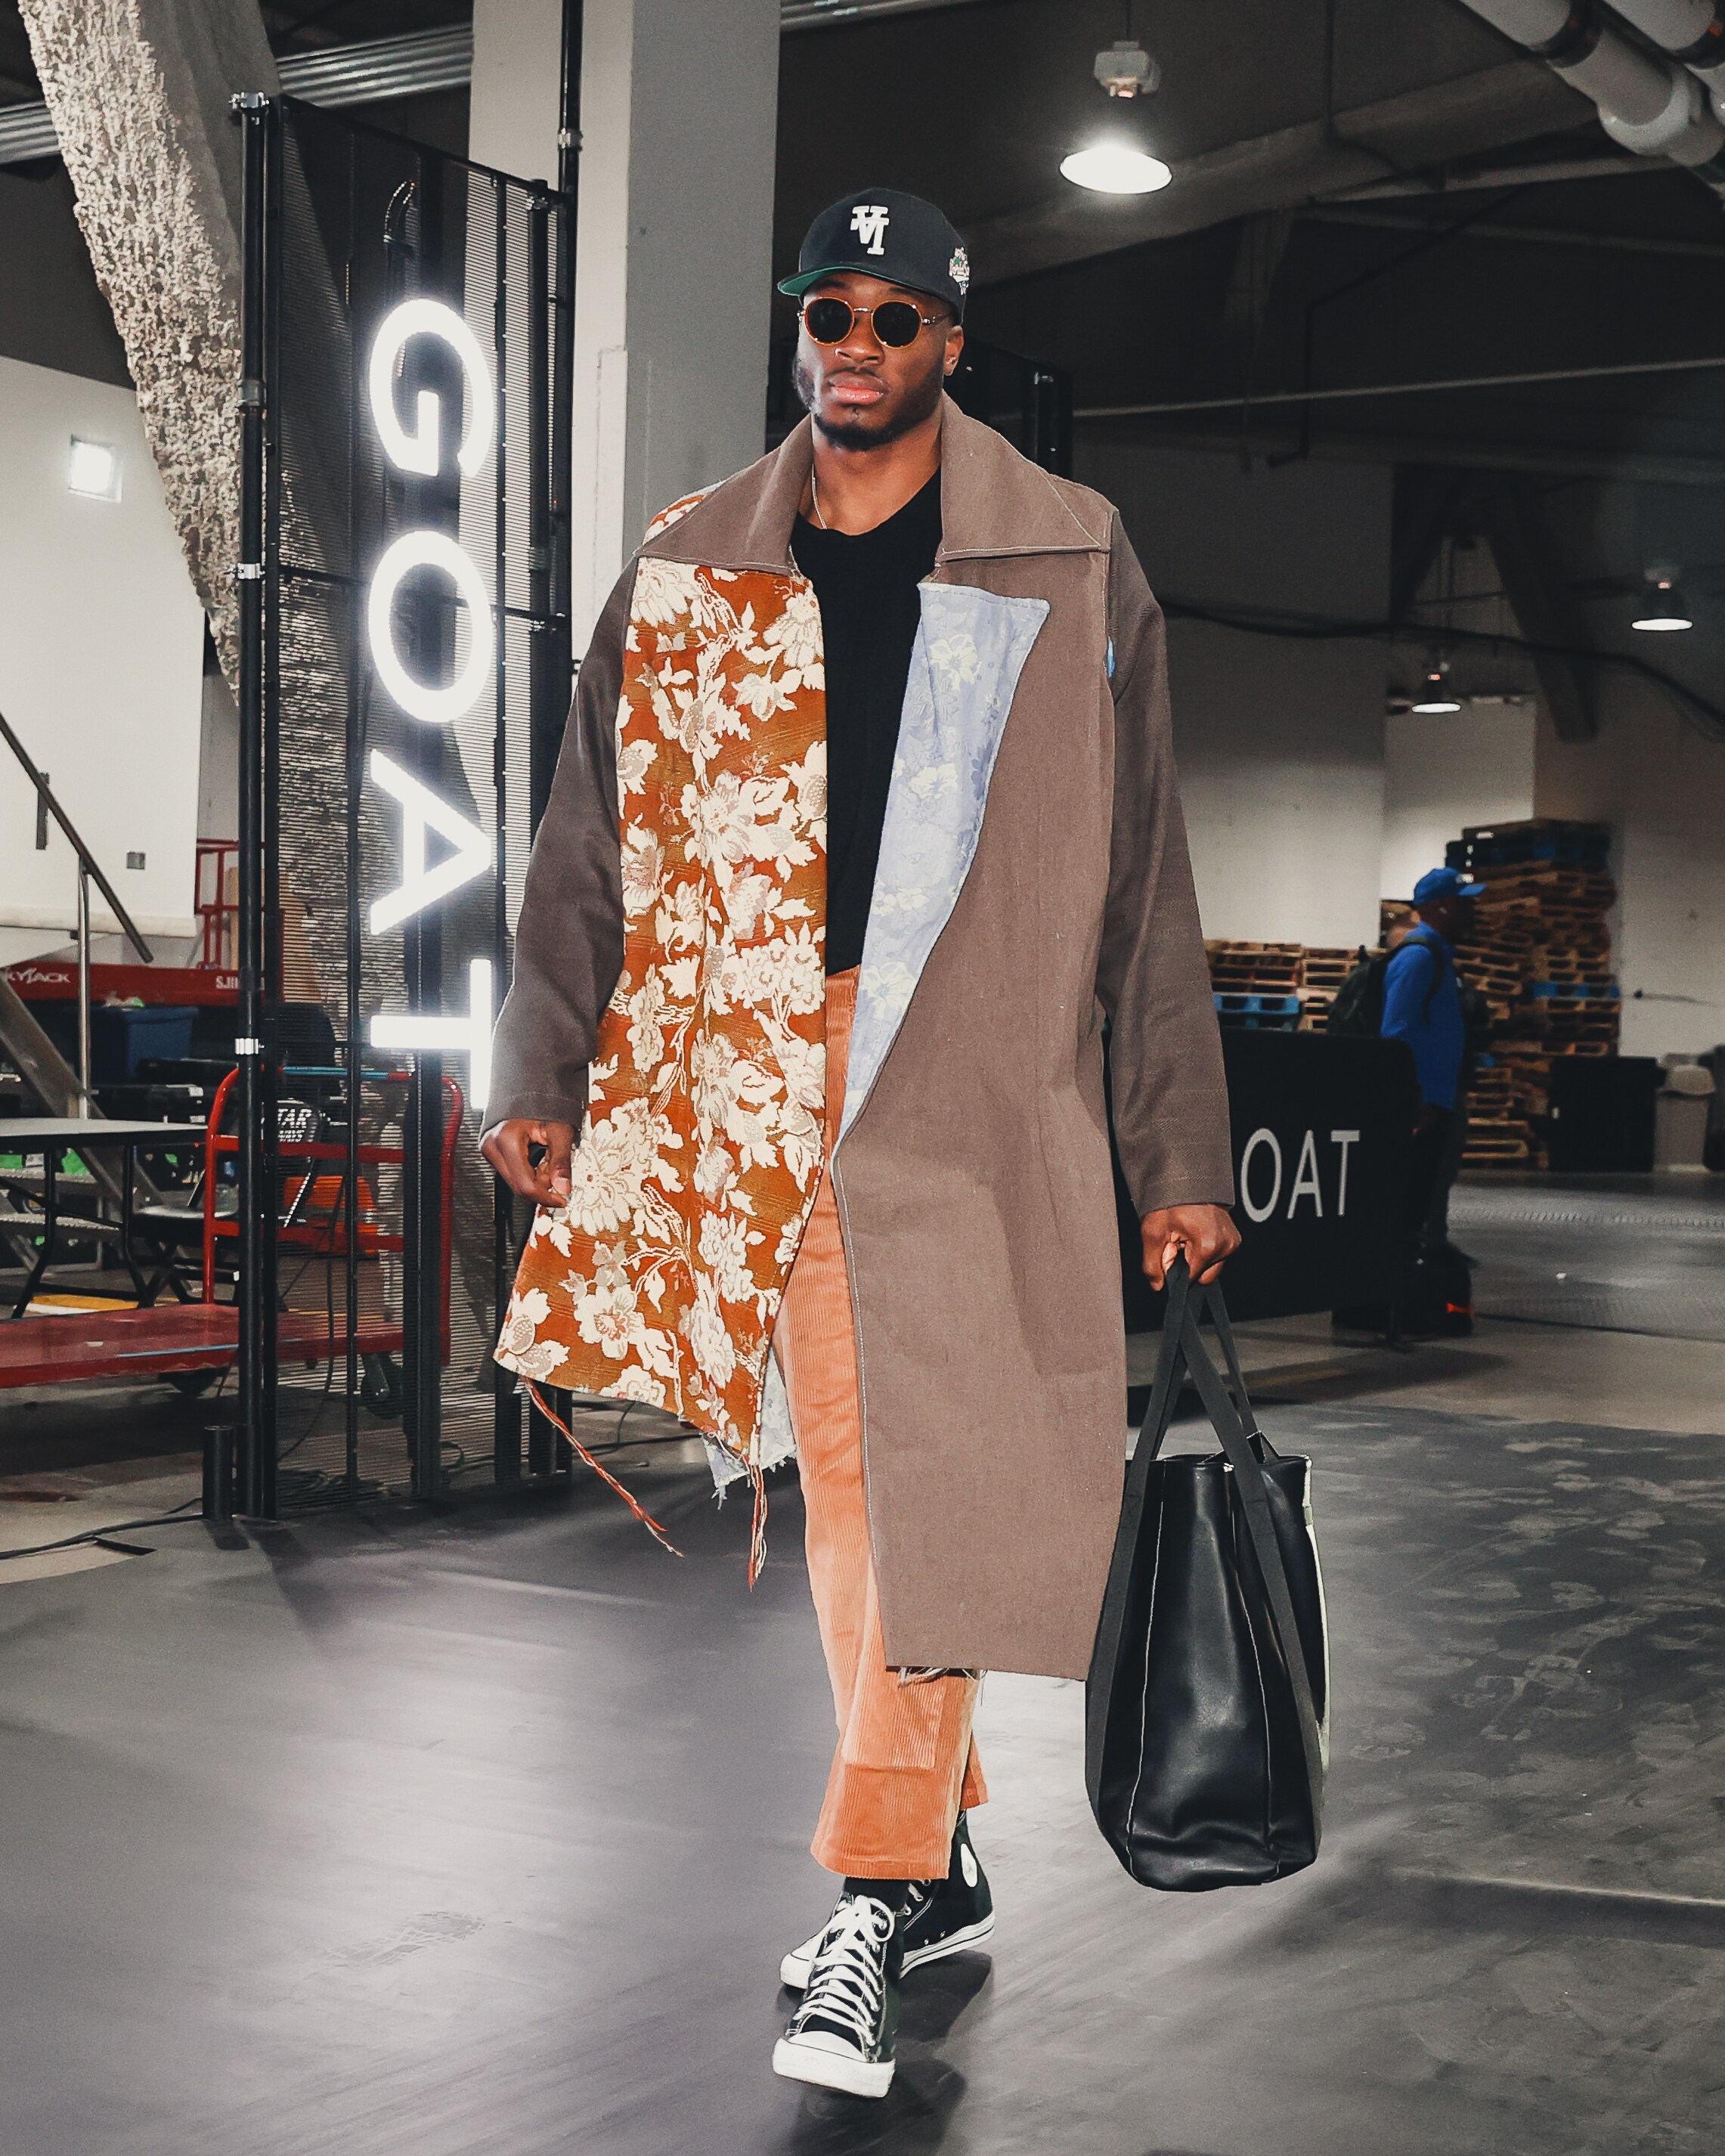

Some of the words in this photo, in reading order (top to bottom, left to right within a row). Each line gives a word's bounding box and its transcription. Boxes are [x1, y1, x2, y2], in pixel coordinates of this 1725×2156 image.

[369, 298, 495, 1109] GOAT
[5, 968, 71, 984] KYJACK
[1240, 1128, 1360, 1222] OAT
